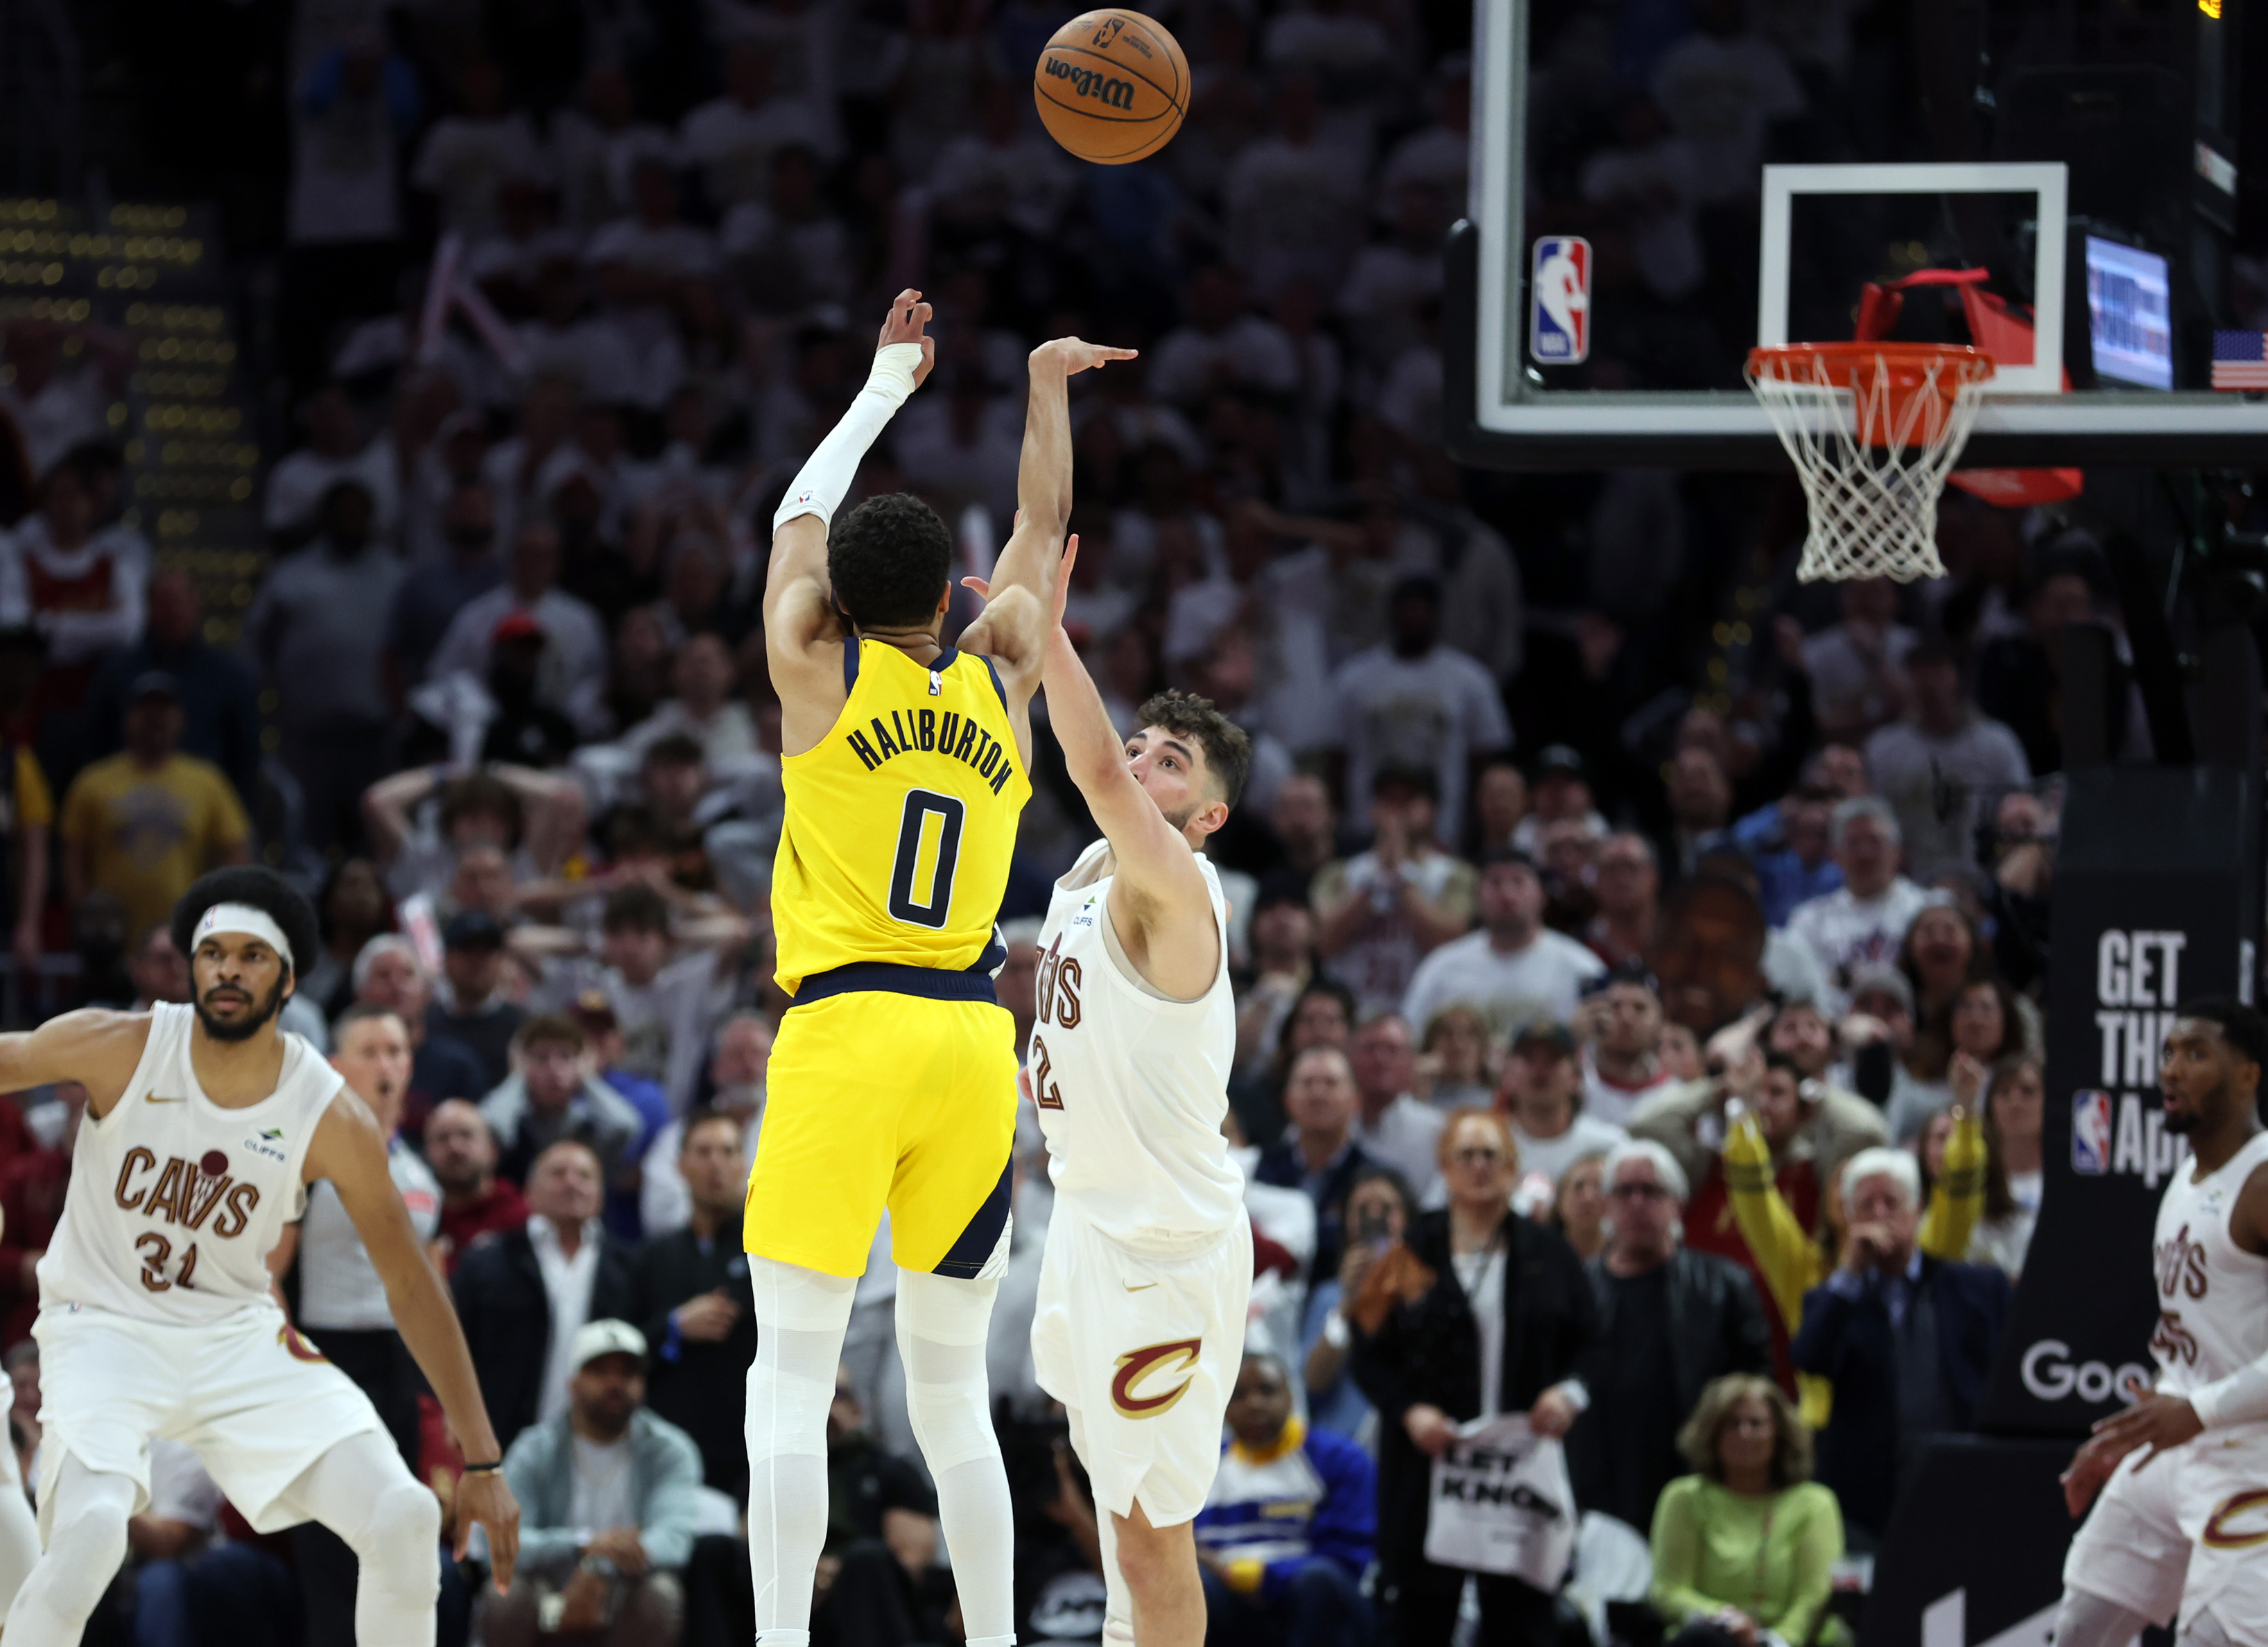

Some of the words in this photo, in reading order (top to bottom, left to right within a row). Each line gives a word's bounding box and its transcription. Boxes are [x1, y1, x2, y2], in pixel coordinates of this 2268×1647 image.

[1045, 55, 1134, 111] Wilson
[846, 709, 1013, 797] HALIBURTON
[886, 786, 967, 931] 0
[1073, 915, 1093, 926] CLIFFS
[2097, 929, 2187, 1006] GET
[1033, 1034, 1066, 1111] 2
[2113, 1092, 2188, 1190] Ap
[114, 1146, 260, 1240] CAVS
[135, 1232, 196, 1293] 31
[2020, 1338, 2158, 1404] Goo
